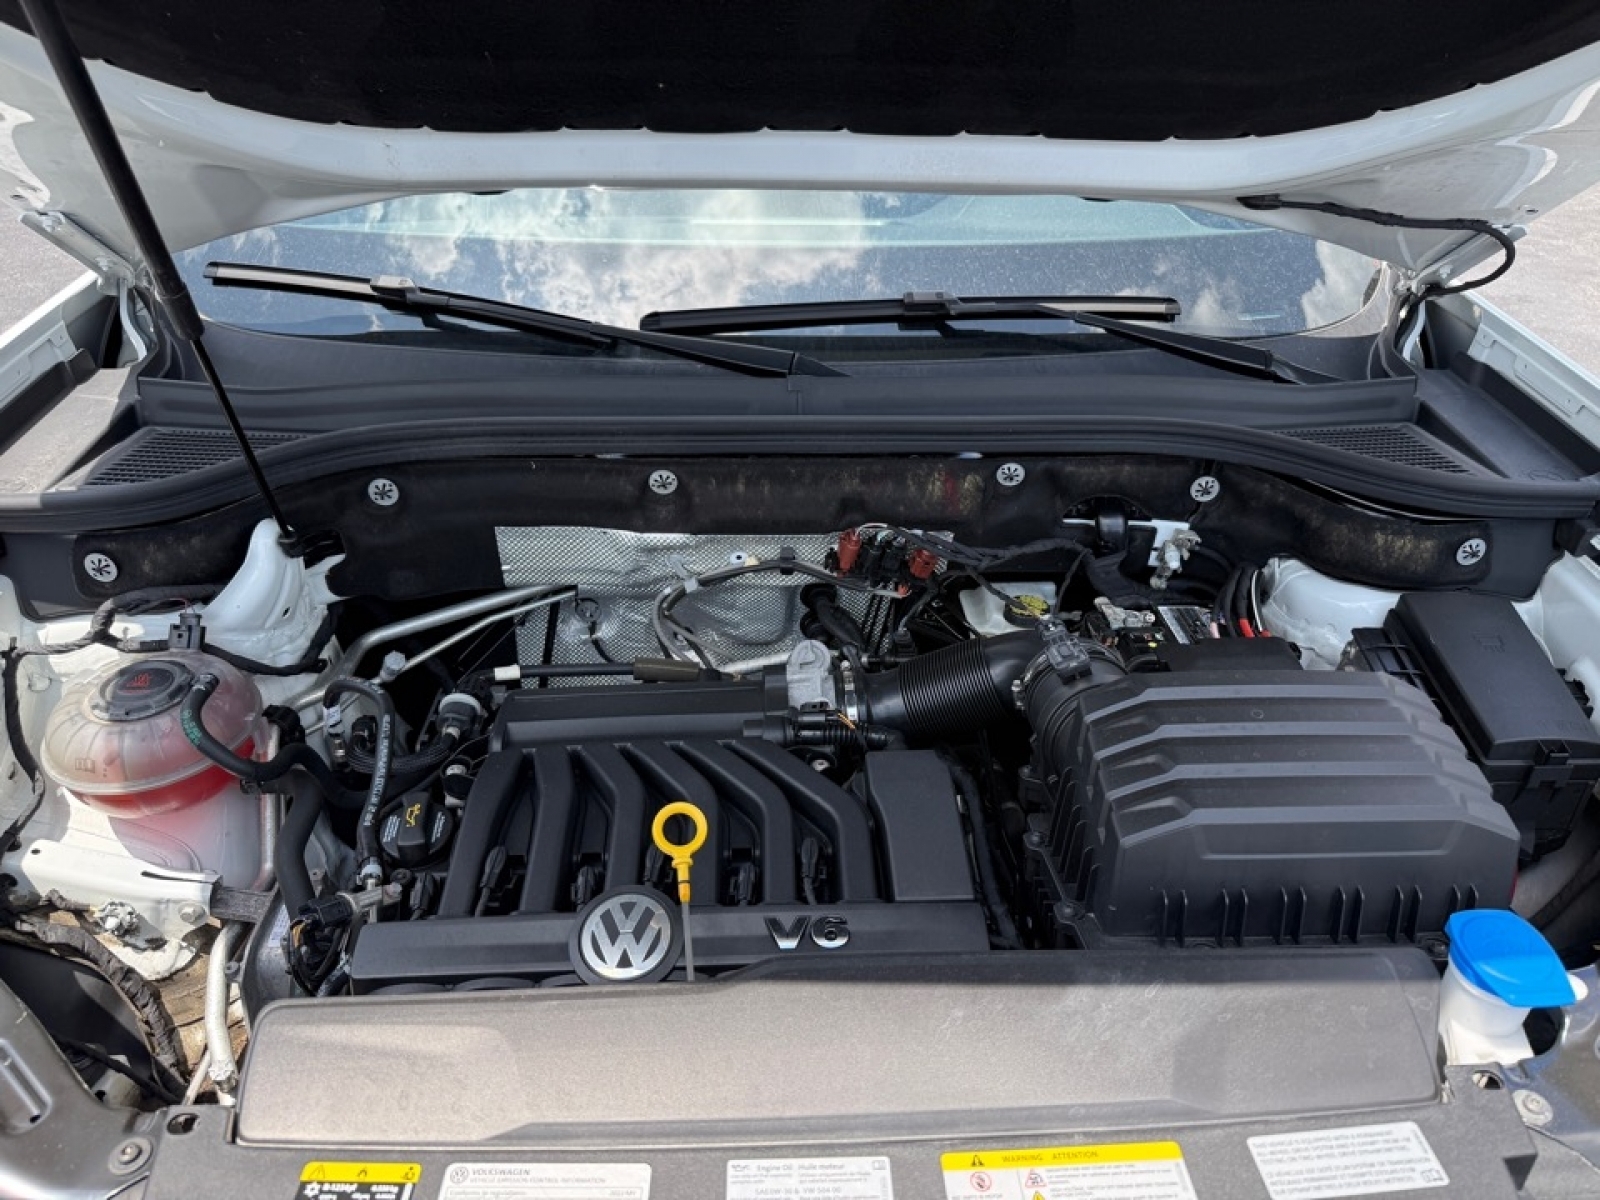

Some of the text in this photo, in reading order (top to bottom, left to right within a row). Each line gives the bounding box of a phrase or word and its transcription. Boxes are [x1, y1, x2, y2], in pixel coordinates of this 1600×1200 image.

[763, 915, 851, 950] V6
[1001, 1151, 1099, 1163] WARNING ATTENTION
[757, 1163, 781, 1173] Engine
[798, 1163, 845, 1171] Huile moteur
[472, 1168, 531, 1177] VOLKSWAGEN
